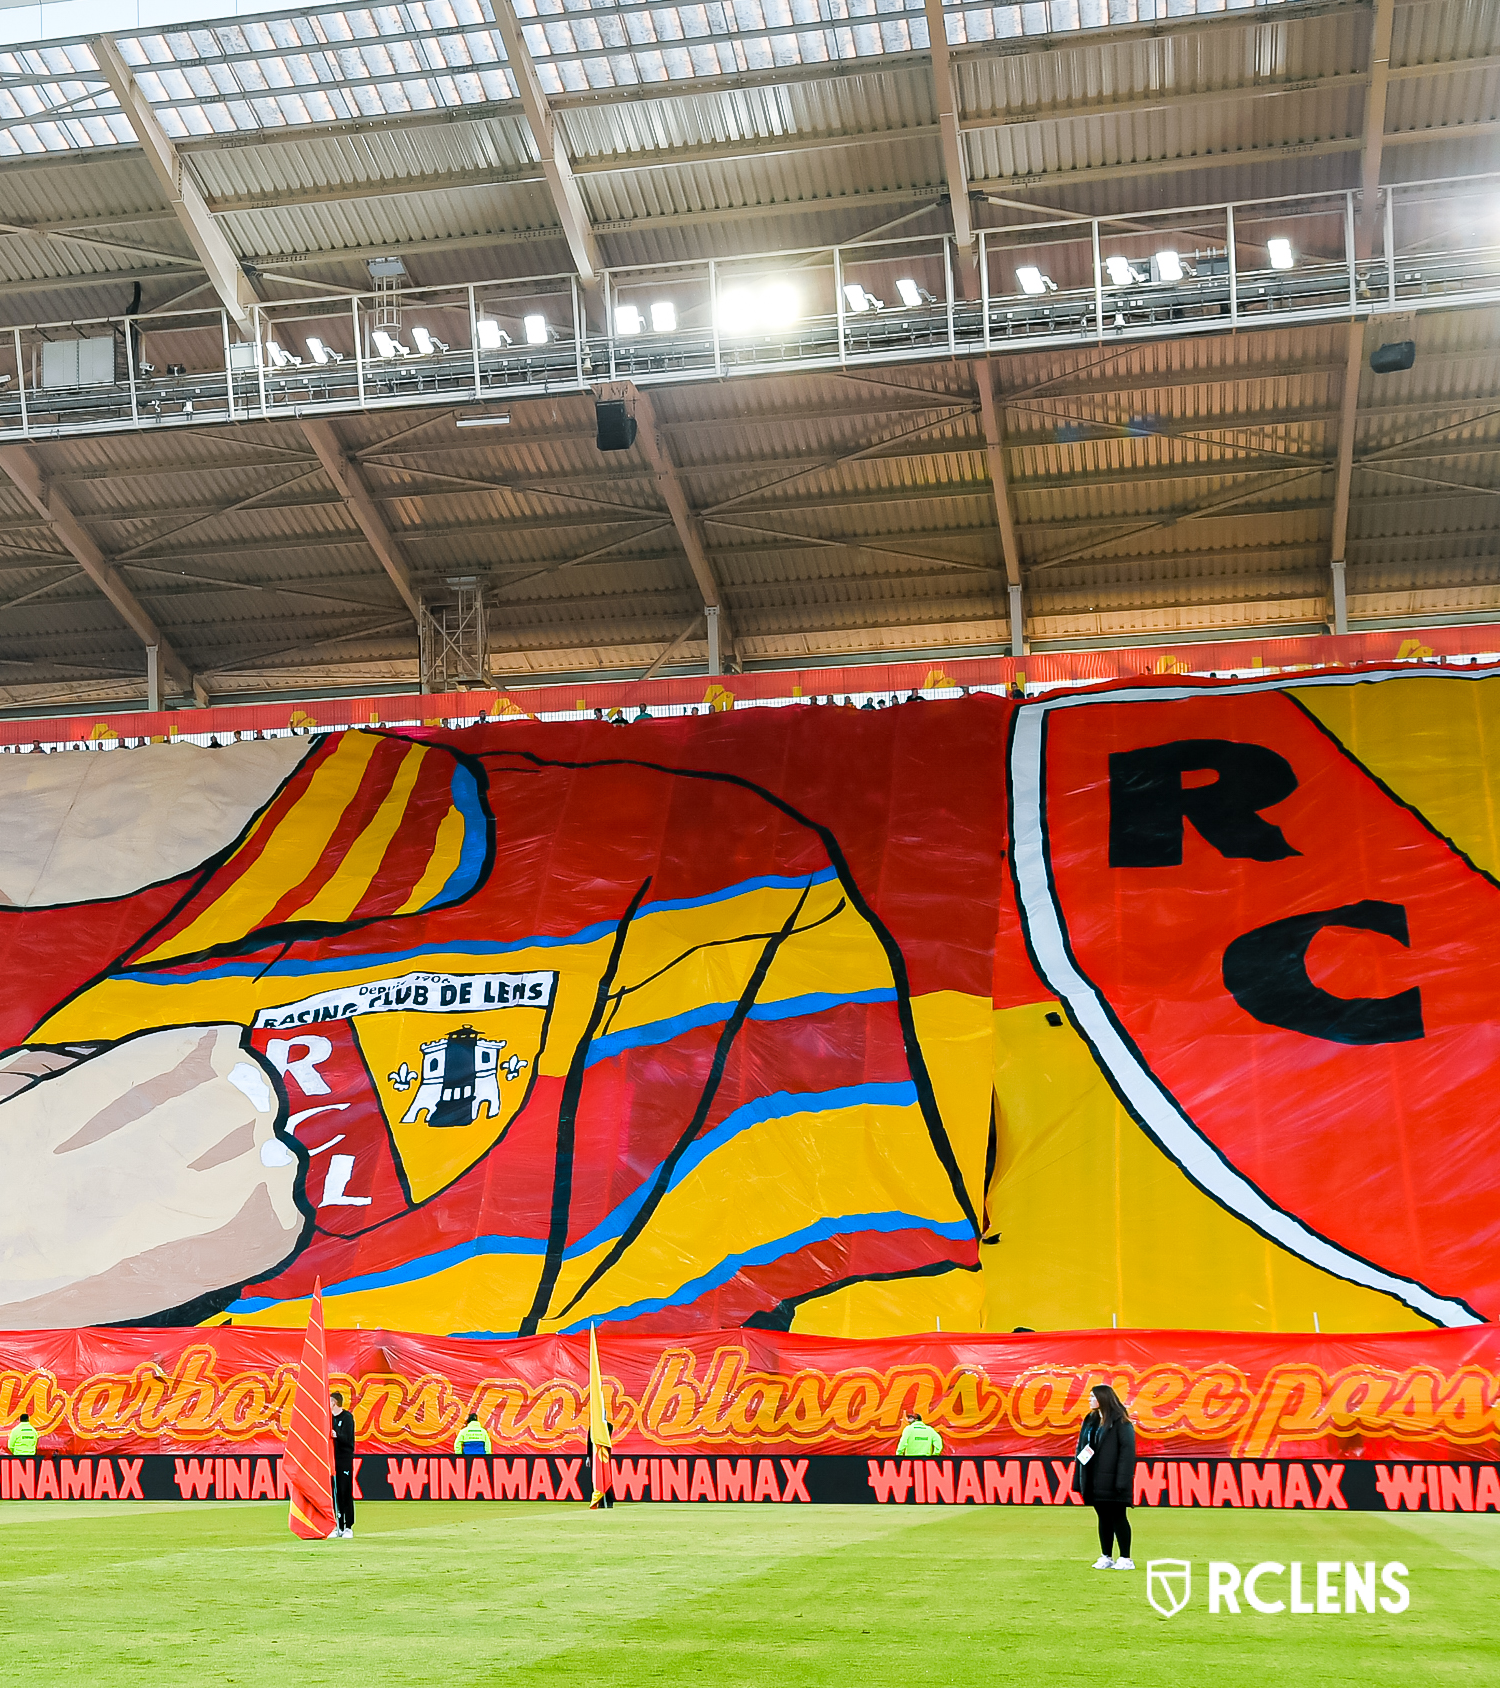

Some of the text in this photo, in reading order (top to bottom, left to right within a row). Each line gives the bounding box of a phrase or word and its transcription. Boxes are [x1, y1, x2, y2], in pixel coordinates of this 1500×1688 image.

[440, 984, 473, 1007] DE
[484, 980, 544, 1003] LENS
[67, 1344, 465, 1447] arborns
[636, 1344, 1006, 1446] blasons
[1231, 1362, 1500, 1459] pass
[386, 1457, 584, 1501] WINAMAX
[610, 1457, 811, 1503] WINAMAX
[867, 1458, 1085, 1505] WINAMAX
[1133, 1460, 1349, 1509] WINAMAX
